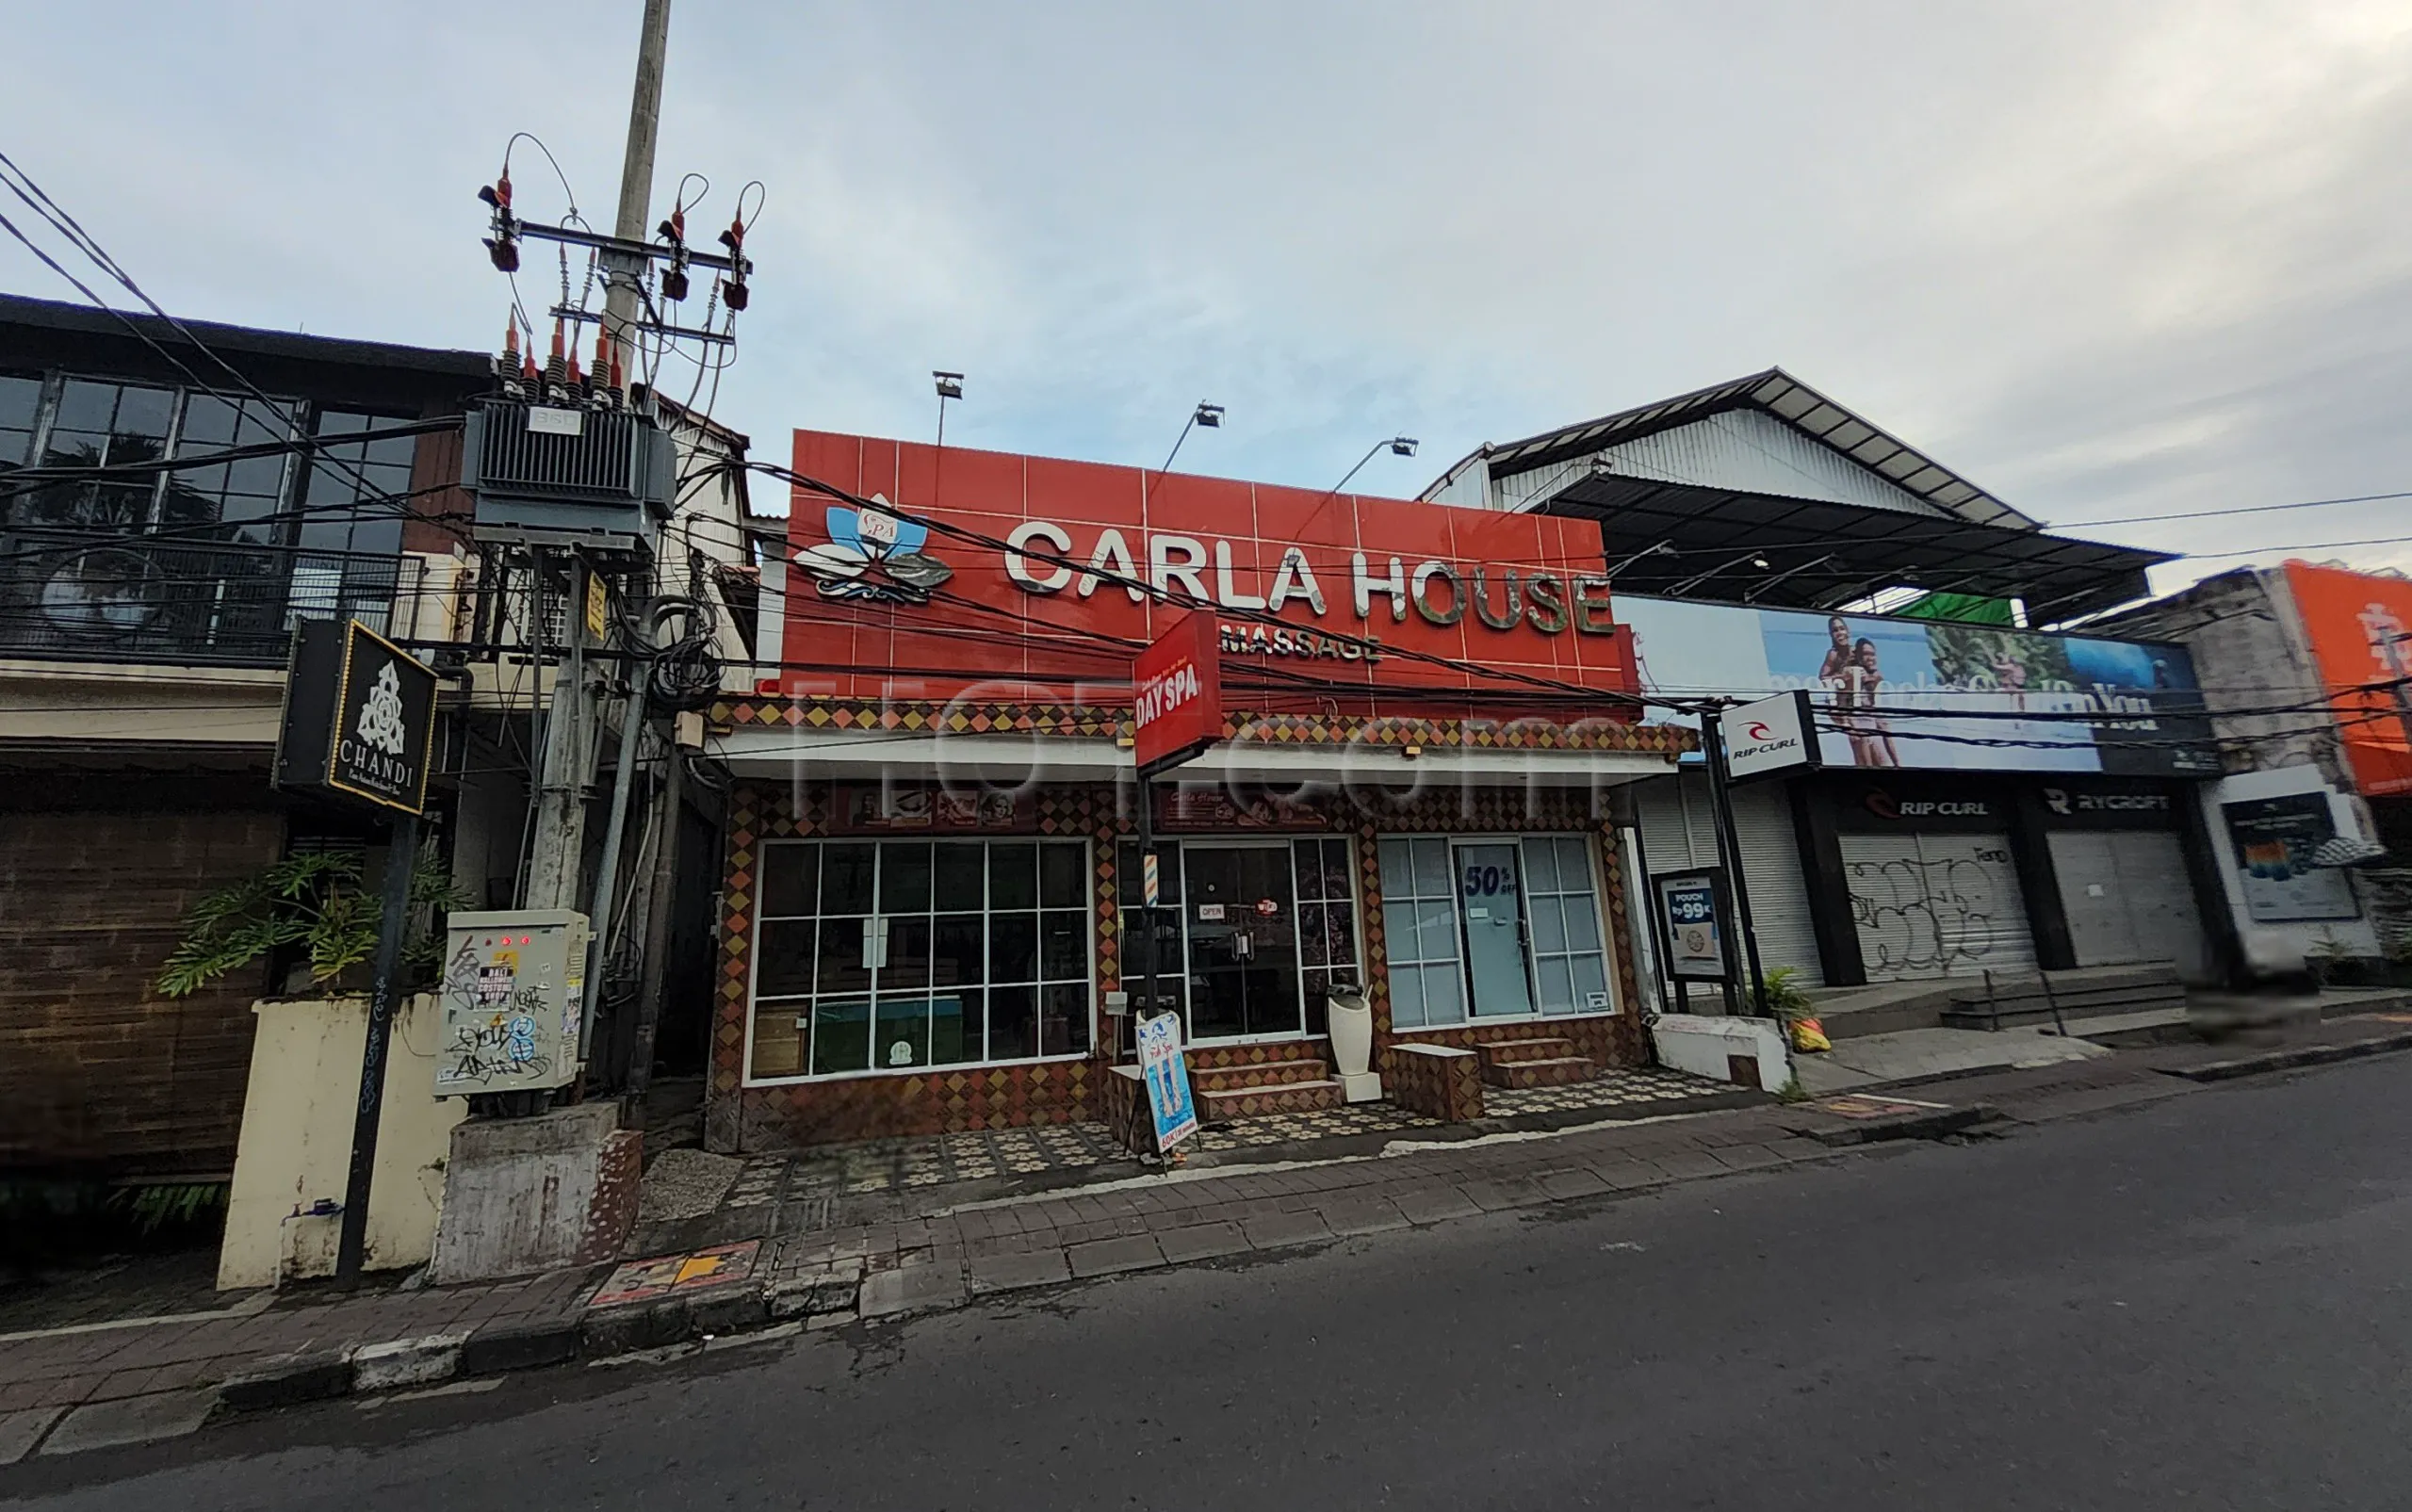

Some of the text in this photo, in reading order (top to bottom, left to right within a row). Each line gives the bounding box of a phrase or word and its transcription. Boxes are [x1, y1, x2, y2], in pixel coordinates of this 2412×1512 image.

[1004, 521, 1616, 634] CARLA HOUSE
[1221, 625, 1383, 660] MASSAGE
[1136, 683, 1163, 730] DAY
[1165, 663, 1198, 711] SPA
[340, 740, 413, 788] CHANDI
[1734, 738, 1798, 759] RIP CURL
[1900, 802, 1989, 816] RIP CURL
[1675, 893, 1703, 902] POUCH
